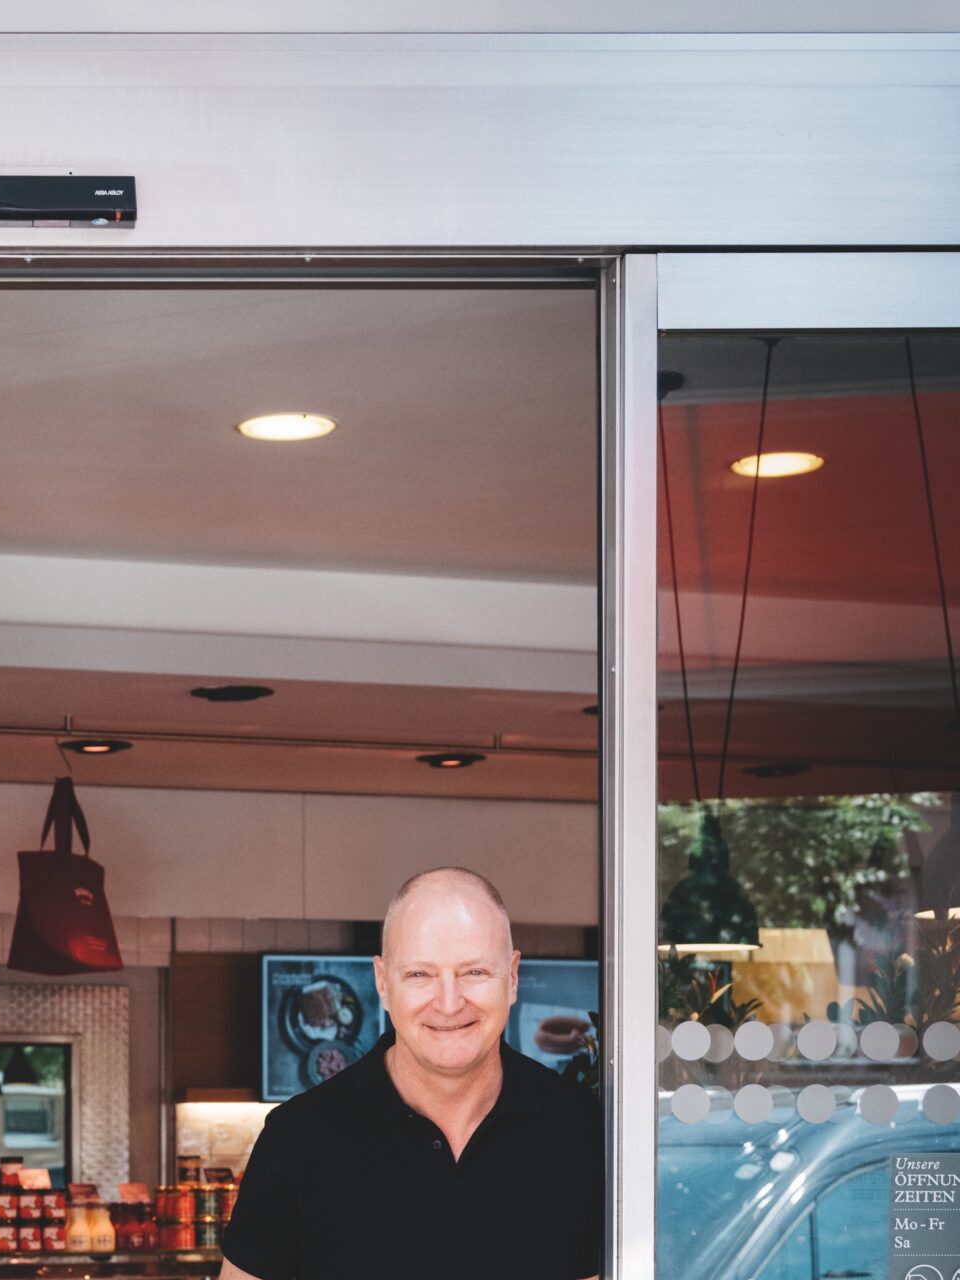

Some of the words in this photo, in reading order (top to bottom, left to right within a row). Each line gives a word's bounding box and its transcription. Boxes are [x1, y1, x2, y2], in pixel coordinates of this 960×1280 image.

[896, 1157, 940, 1170] Unsere
[895, 1190, 955, 1203] ZEITEN
[894, 1217, 918, 1230] Mo
[928, 1217, 945, 1230] Fr
[894, 1235, 910, 1248] Sa
